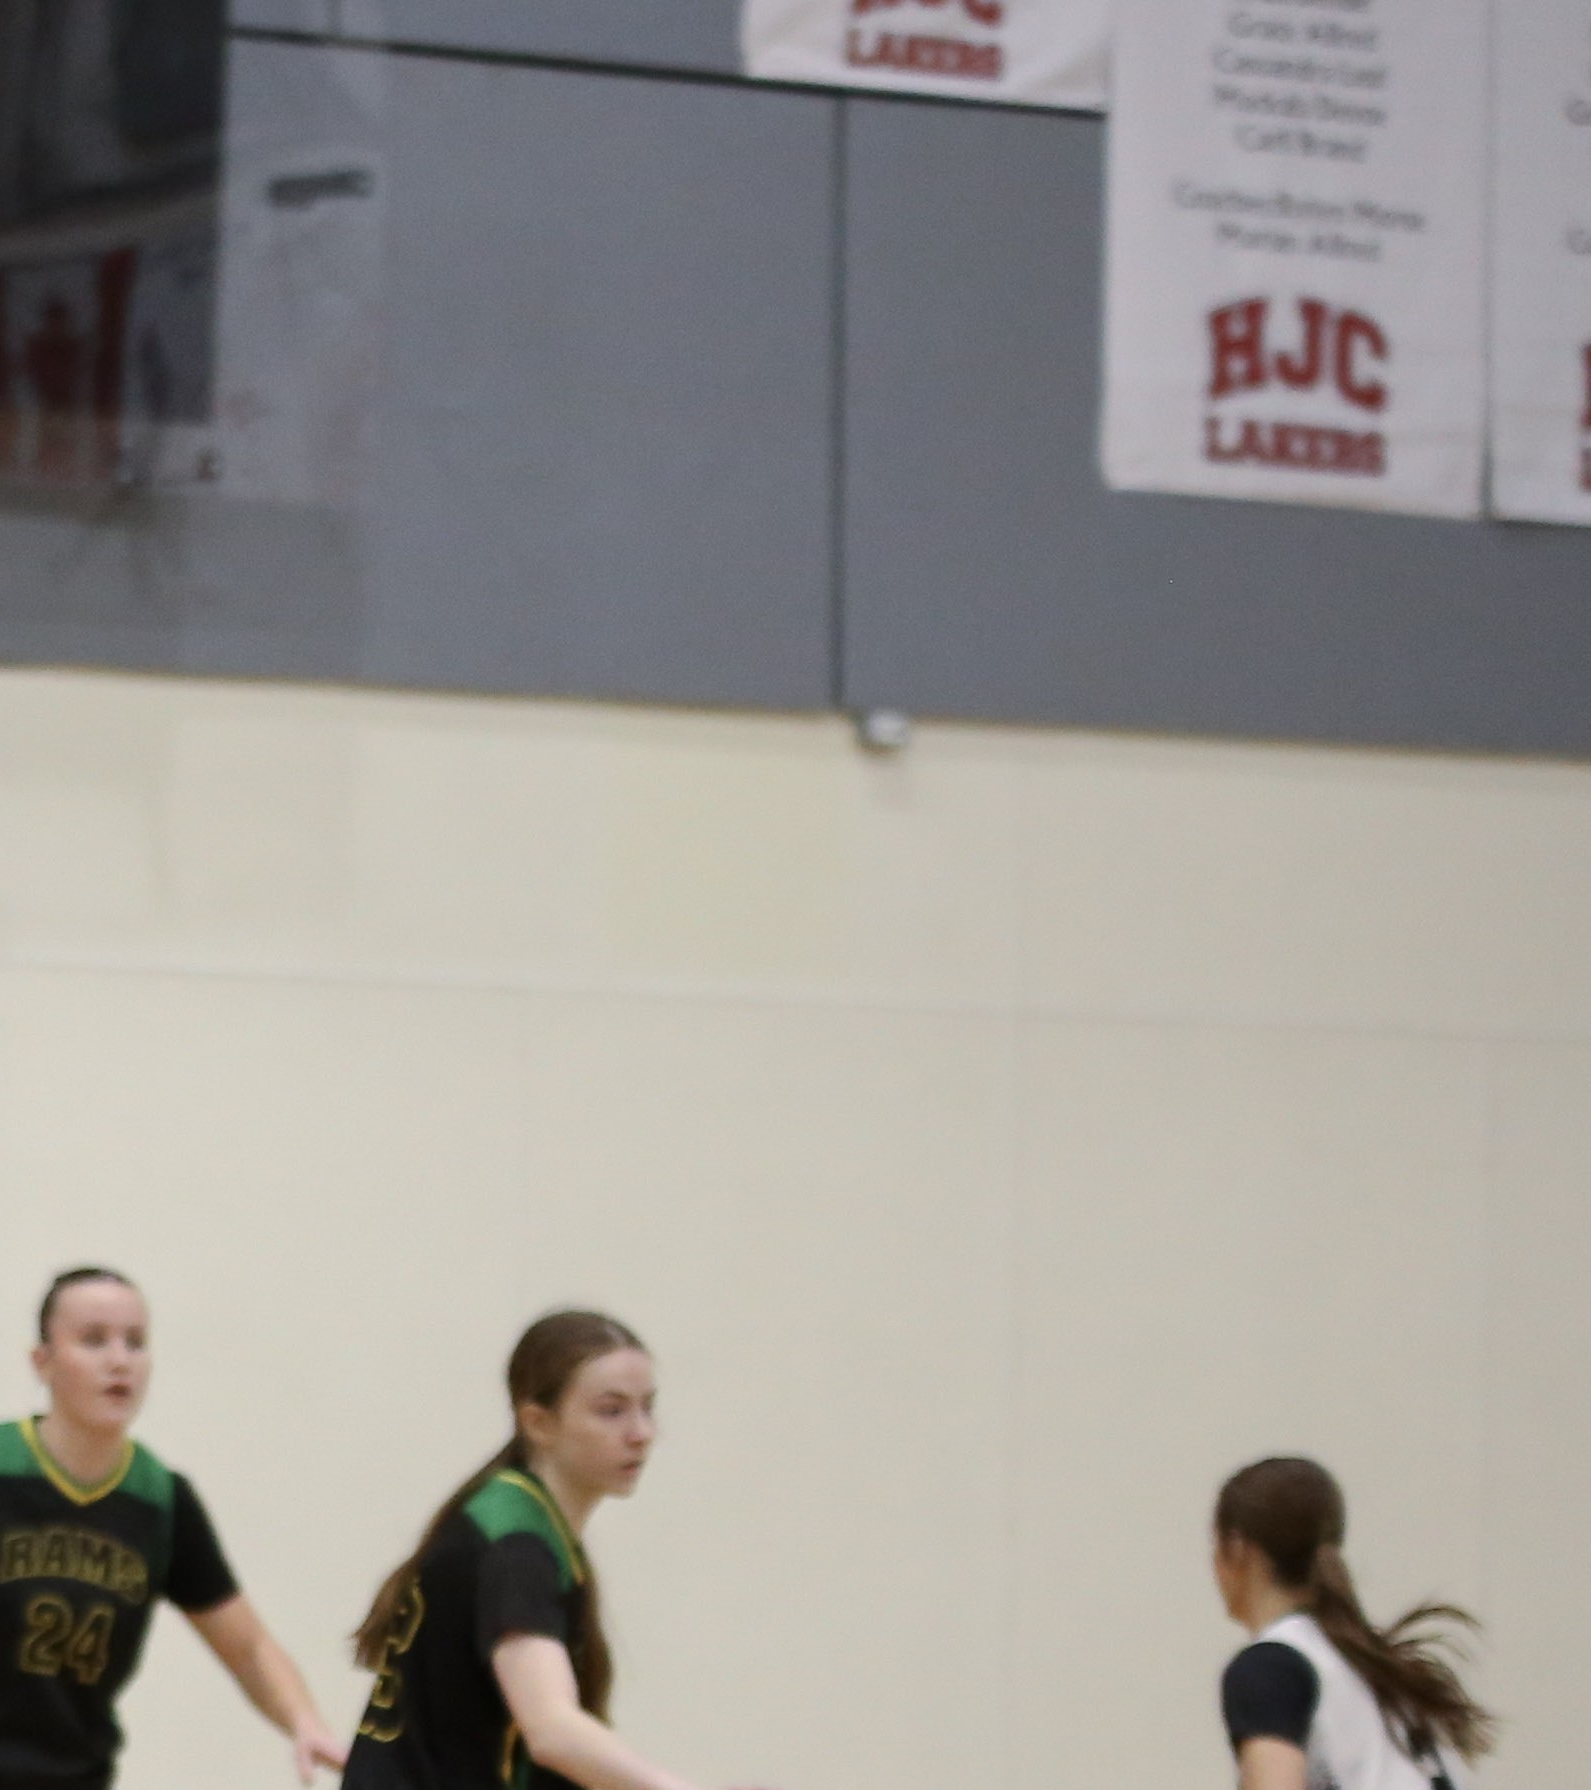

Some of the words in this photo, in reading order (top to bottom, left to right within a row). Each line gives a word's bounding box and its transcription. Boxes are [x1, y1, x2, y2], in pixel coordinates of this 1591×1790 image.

[1208, 297, 1388, 412] HJC
[1204, 416, 1386, 478] LAKERS
[19, 1594, 116, 1684] 24
